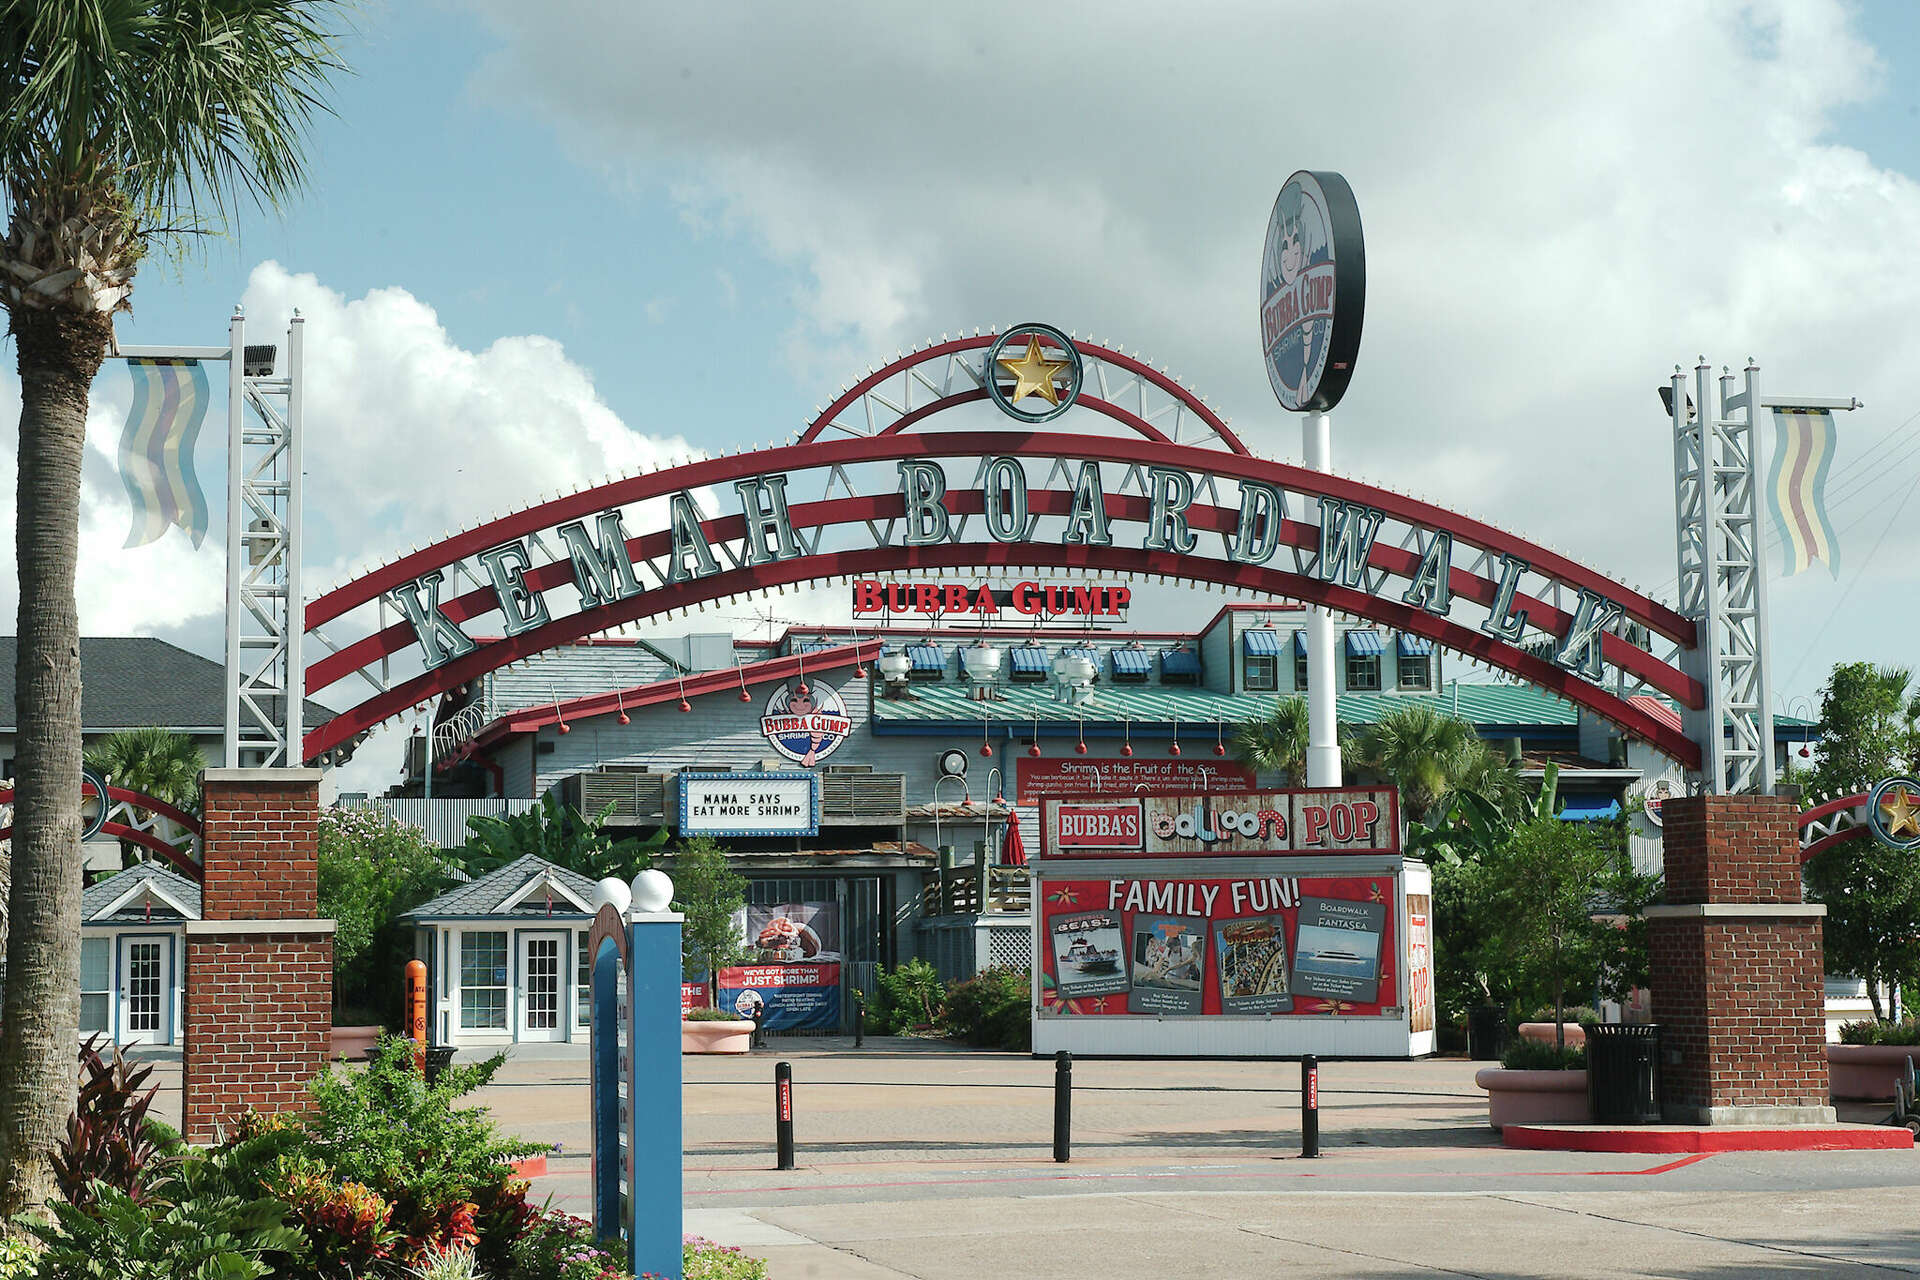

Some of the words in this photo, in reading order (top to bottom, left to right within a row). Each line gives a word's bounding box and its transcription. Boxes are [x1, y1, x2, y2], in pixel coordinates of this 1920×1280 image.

[1264, 287, 1300, 342] BUBBA
[1300, 273, 1334, 316] GUMP
[395, 473, 800, 671] KEMAH
[897, 456, 1624, 681] BOARDWALK
[854, 580, 999, 614] BUBBA
[1012, 581, 1131, 616] GUMP
[765, 717, 808, 733] BUBBA
[811, 715, 848, 733] GUMP
[778, 732, 809, 741] SHRIMP
[1101, 763, 1109, 773] is
[1112, 763, 1130, 774] the
[1133, 762, 1158, 774] Fruit
[1160, 763, 1172, 774] of
[1177, 763, 1194, 774] the
[704, 794, 738, 804] MAMA
[750, 794, 781, 804] SAYS
[693, 806, 715, 816] EAT
[720, 806, 750, 816] MORE
[758, 806, 801, 816] SHRIMP
[1061, 814, 1137, 837] BUBBA'S
[1302, 800, 1379, 845] POP
[1108, 879, 1220, 917] FAMILY
[1231, 877, 1301, 914] FUN!
[1320, 902, 1369, 915] BOARDWALK
[1318, 917, 1368, 930] FANTASEA
[742, 976, 772, 986] JUST
[774, 975, 819, 985] SHRIMP!
[682, 987, 702, 996] THE
